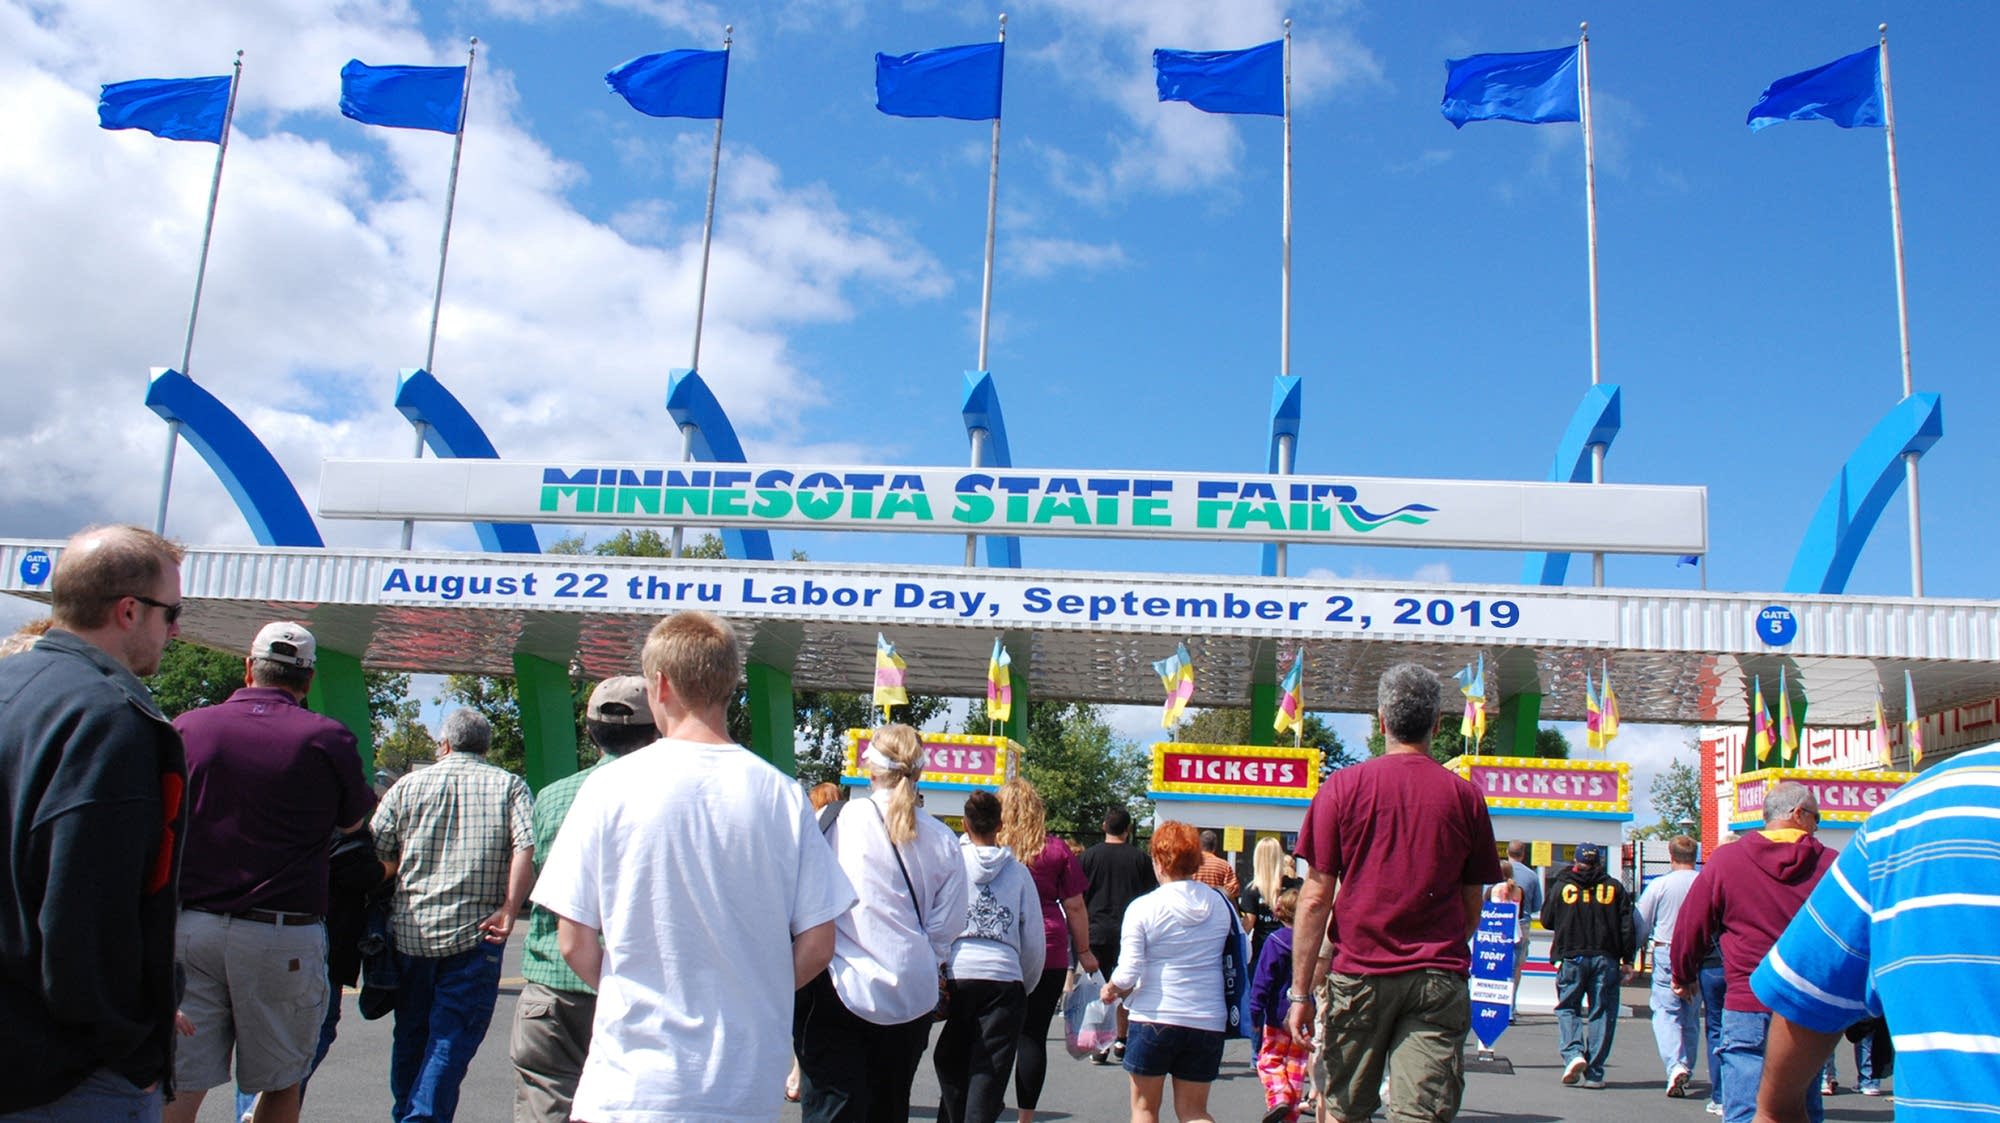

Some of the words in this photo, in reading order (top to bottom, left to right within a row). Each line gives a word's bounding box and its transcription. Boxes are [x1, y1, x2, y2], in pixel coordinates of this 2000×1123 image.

[538, 468, 934, 521] MINNESOTA
[952, 473, 1174, 527] STATE
[1197, 480, 1438, 532] FAIR
[26, 554, 48, 563] GATE
[30, 562, 40, 574] 5
[383, 568, 536, 601] August
[554, 572, 609, 598] 22
[627, 576, 722, 602] thru
[742, 578, 881, 607] Labor
[895, 583, 1000, 618] Day,
[1023, 587, 1308, 622] September
[1327, 595, 1372, 629] 2,
[1395, 598, 1520, 629] 2019
[1762, 610, 1790, 619] GATE
[1771, 620, 1782, 633] 5
[922, 747, 982, 769] KETS
[1178, 758, 1294, 783] TICKETS
[1485, 771, 1604, 796] TICKETS
[1481, 907, 1513, 919] Welcome
[1480, 951, 1505, 961] TODAY
[1486, 962, 1496, 970] IS
[1481, 1008, 1497, 1018] DAY
